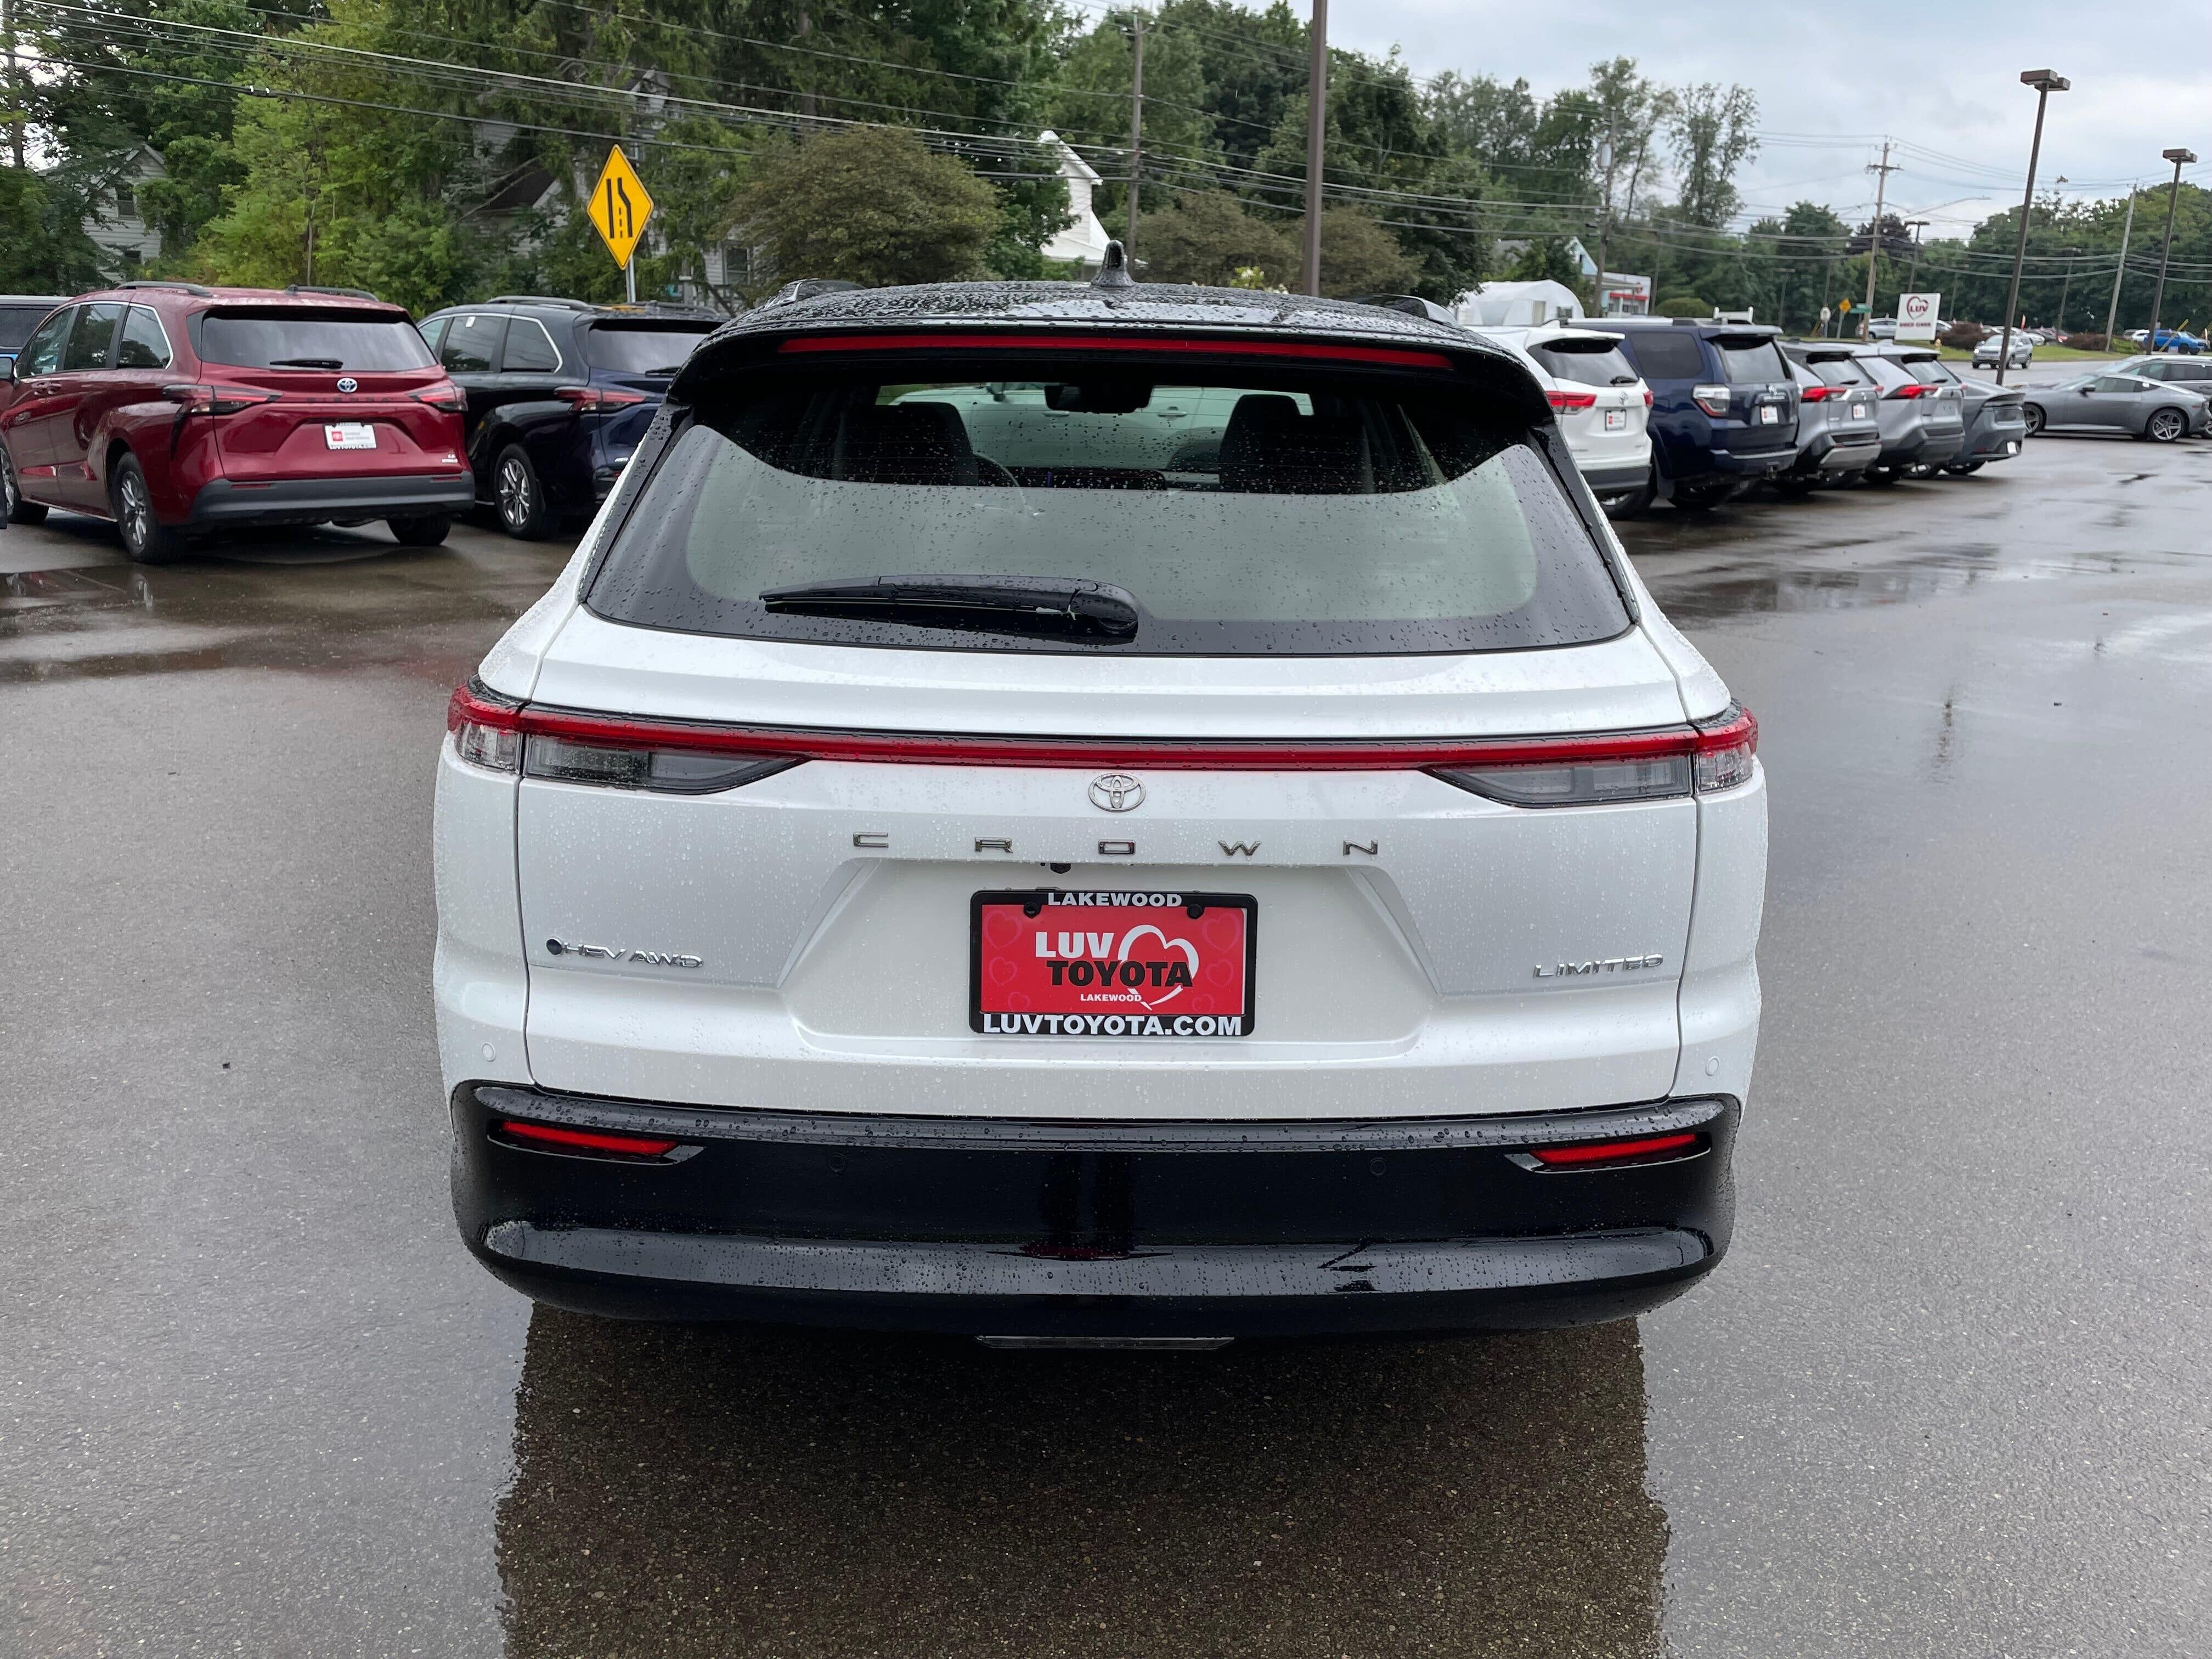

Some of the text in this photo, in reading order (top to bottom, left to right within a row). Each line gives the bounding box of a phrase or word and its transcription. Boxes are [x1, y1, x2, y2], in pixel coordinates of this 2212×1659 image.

[852, 830, 1379, 857] CROWN
[1047, 892, 1183, 908] LAKEWOOD
[1035, 931, 1115, 959] LUV
[628, 949, 704, 968] AWD
[1532, 953, 1664, 979] LIMITED
[1046, 960, 1193, 988] TOYOTA
[1080, 993, 1142, 1003] LAKEWOOD
[983, 1013, 1242, 1036] LUVTOYOTA.COM
